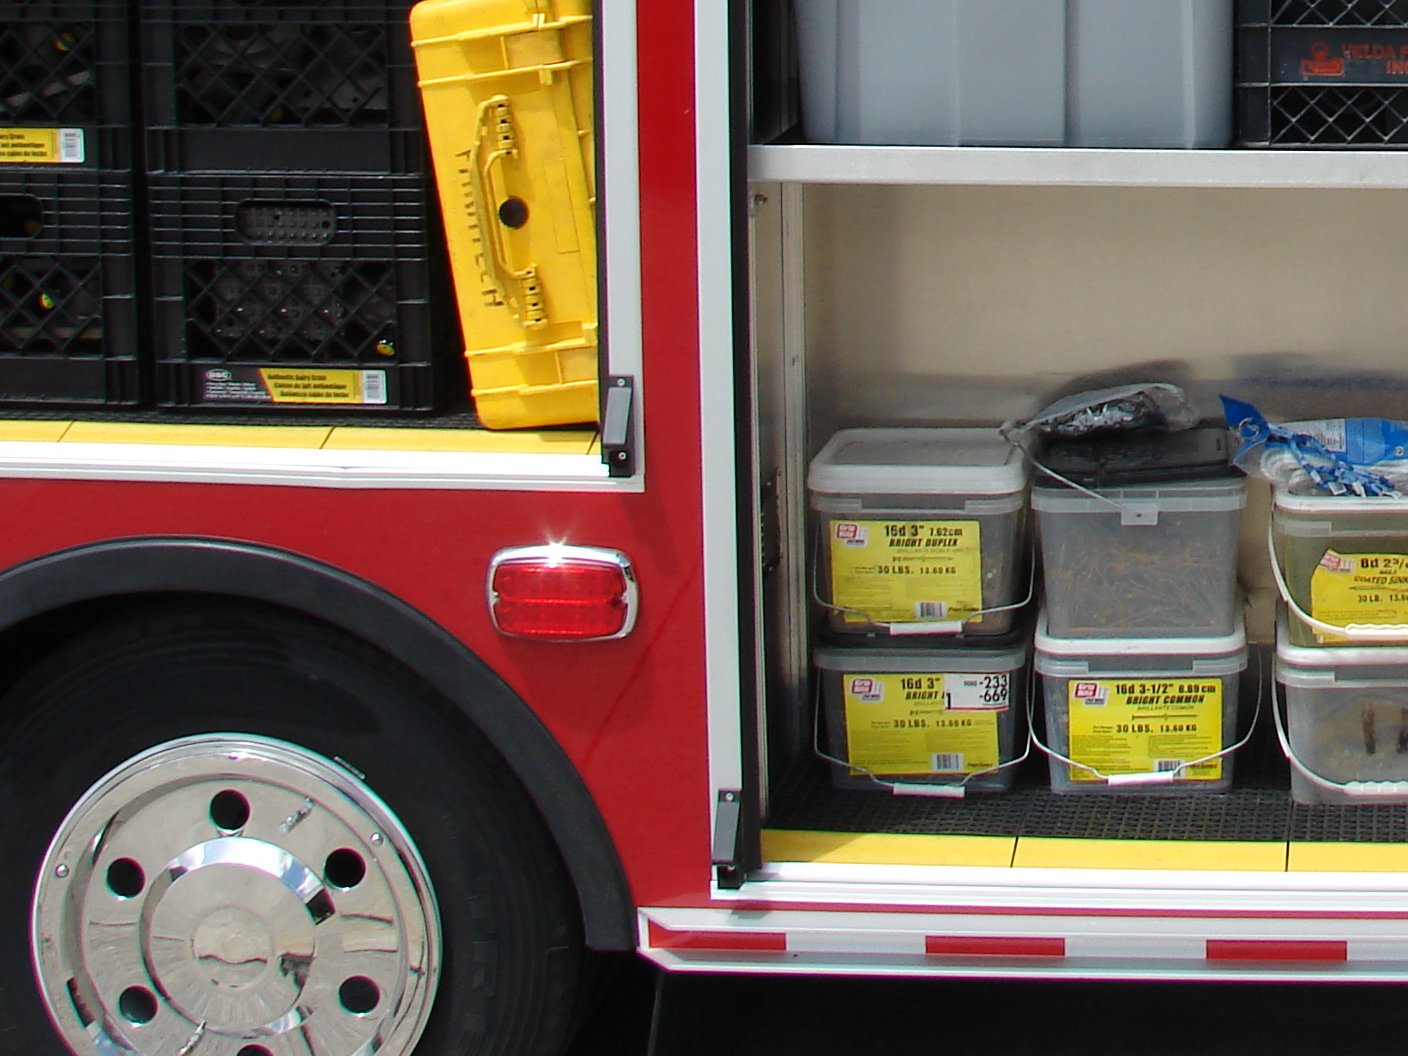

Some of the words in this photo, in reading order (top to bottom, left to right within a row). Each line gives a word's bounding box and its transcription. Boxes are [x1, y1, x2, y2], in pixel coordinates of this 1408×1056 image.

[1341, 45, 1396, 60] VELDA
[884, 525, 907, 537] 16d
[888, 538, 923, 548] BRIGHT
[925, 538, 959, 548] DUPLEX
[876, 565, 890, 574] 30
[892, 565, 915, 575] LBS.
[945, 566, 957, 574] KG
[1354, 576, 1388, 585] COATED
[1357, 594, 1368, 603] 30
[901, 677, 923, 690] 16d
[1115, 684, 1135, 695] 16d
[905, 690, 940, 700] BRIGHT
[1126, 696, 1161, 705] BRIGHT
[1163, 695, 1205, 704] COMMON
[893, 719, 906, 728] 30
[908, 719, 930, 728] LBS.
[961, 719, 972, 727] KG
[1116, 724, 1129, 733] 30
[1131, 724, 1154, 733] LBS.
[1185, 724, 1197, 732] KG
